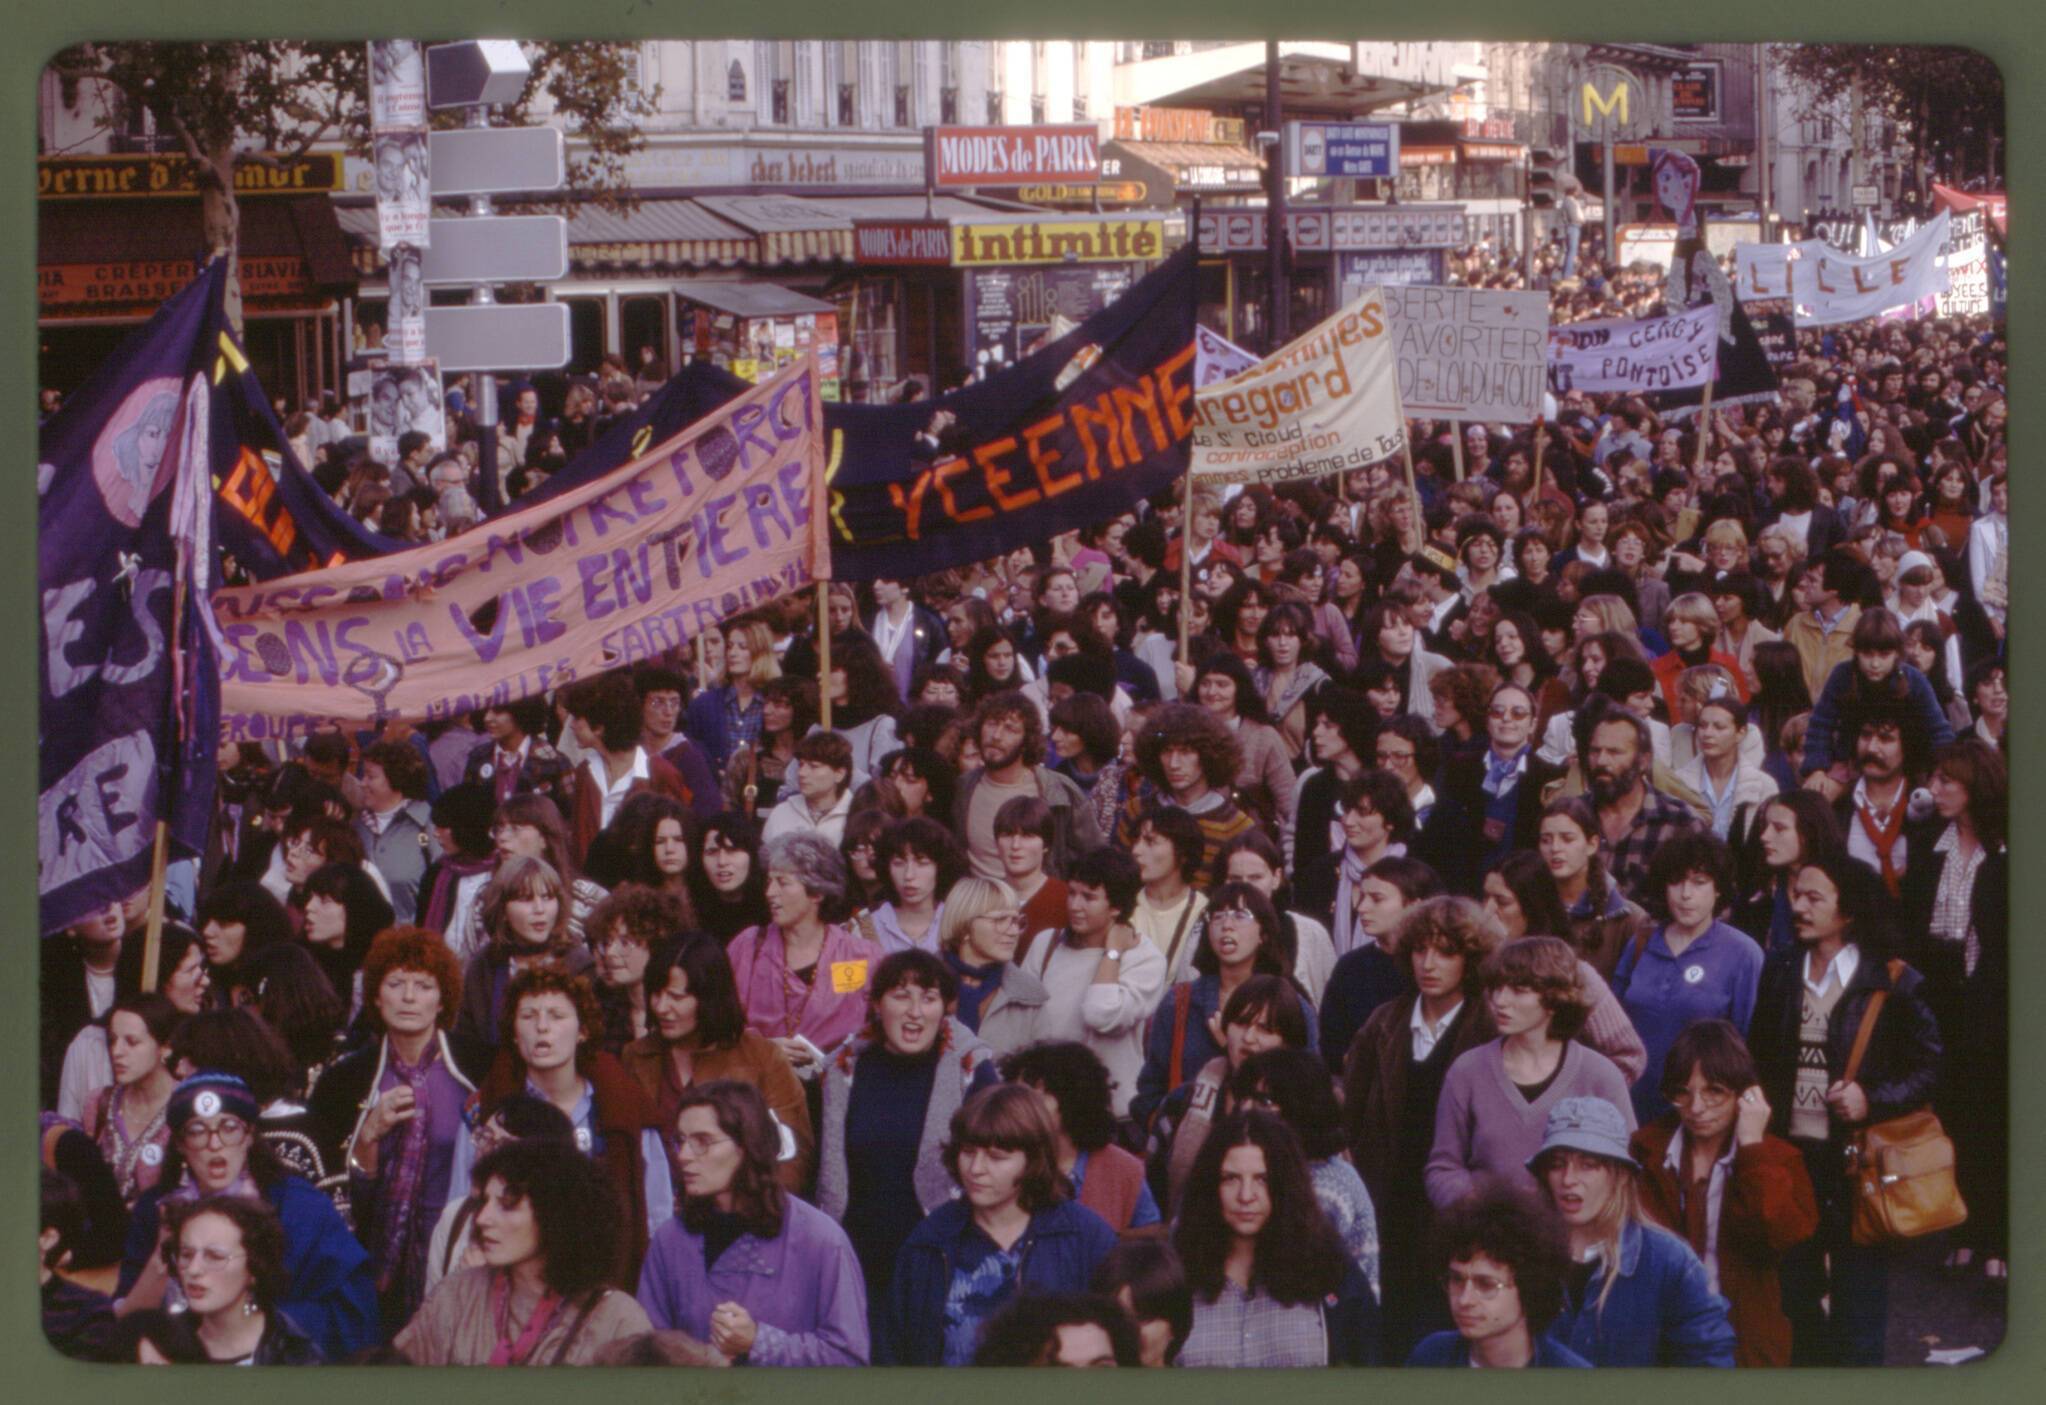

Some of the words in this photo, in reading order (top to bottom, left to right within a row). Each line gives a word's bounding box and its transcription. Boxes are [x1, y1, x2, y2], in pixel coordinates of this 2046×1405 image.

[1583, 81, 1629, 126] M
[940, 135, 1009, 175] MODES
[1010, 136, 1033, 172] de
[1035, 133, 1097, 174] PARIS
[858, 228, 896, 258] MODES
[911, 228, 949, 258] PARIS
[959, 219, 1158, 262] intimité
[1750, 257, 1911, 294] LILLE
[1368, 286, 1488, 324] BERTE
[1392, 321, 1543, 361] 'AVORTER
[1602, 343, 1712, 387] PONTOISE
[888, 340, 1197, 541] YCEENNE
[1205, 430, 1342, 465] contraception
[1244, 421, 1304, 448] Cloud
[1347, 446, 1374, 465] de
[448, 575, 567, 664] VIE
[577, 461, 813, 621] ENTIERE
